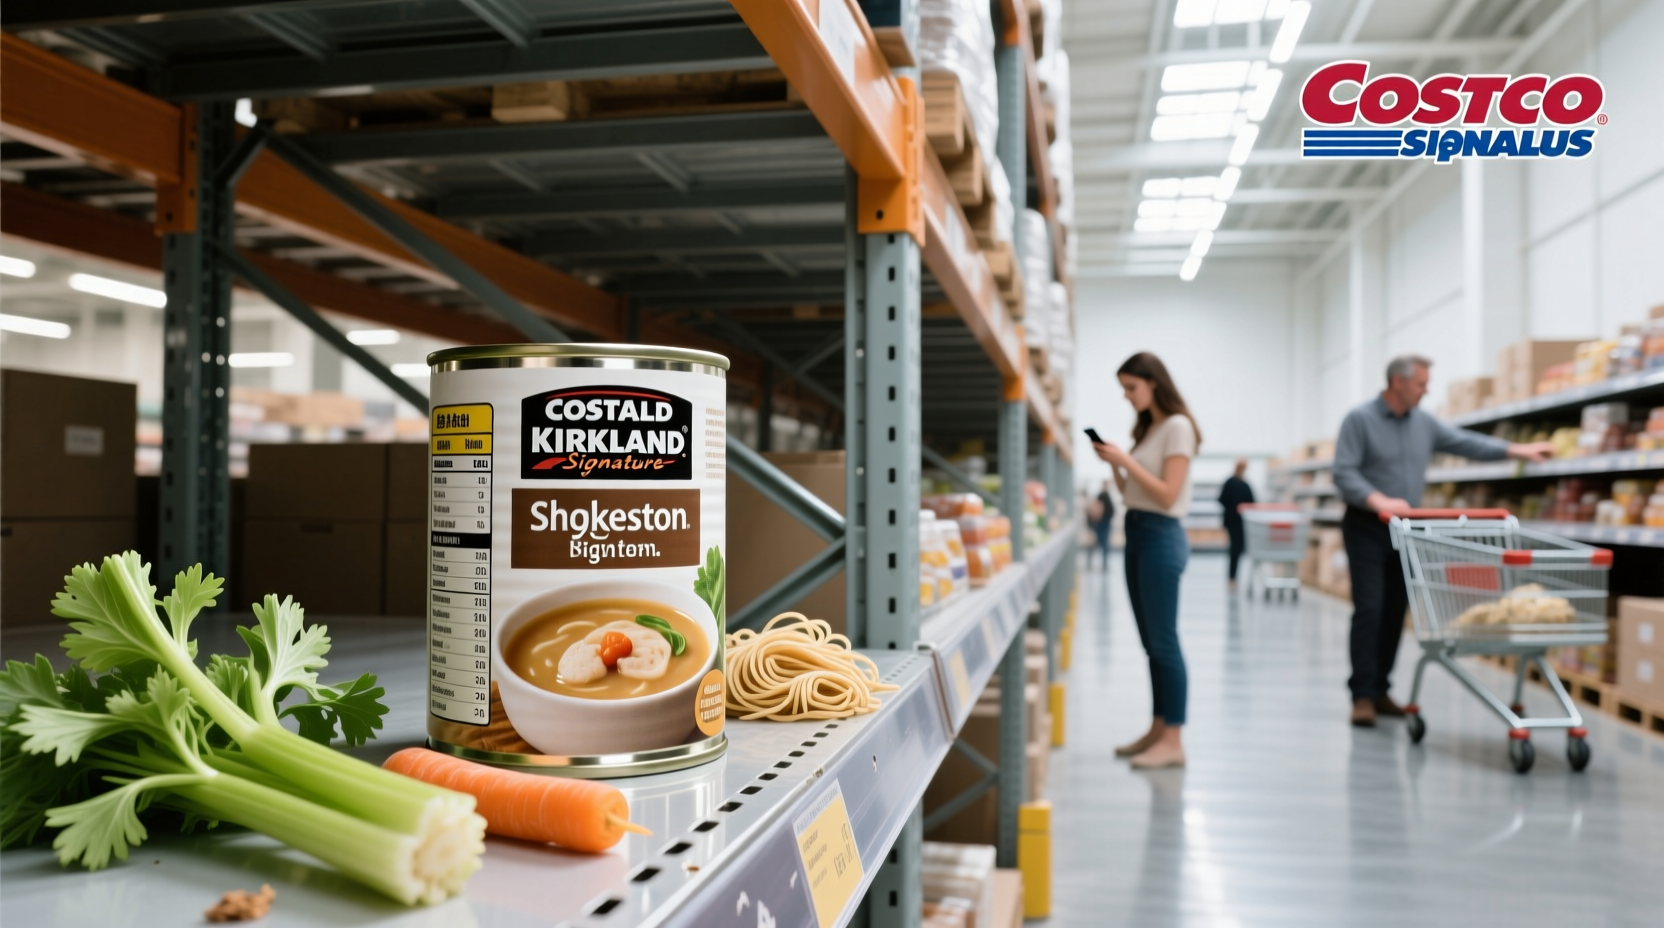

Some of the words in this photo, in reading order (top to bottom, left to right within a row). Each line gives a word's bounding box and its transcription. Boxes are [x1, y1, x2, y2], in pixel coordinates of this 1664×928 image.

[545, 398, 673, 422] COSTALD
[531, 426, 685, 454] KIRKLAND
[562, 452, 665, 477] Signature
